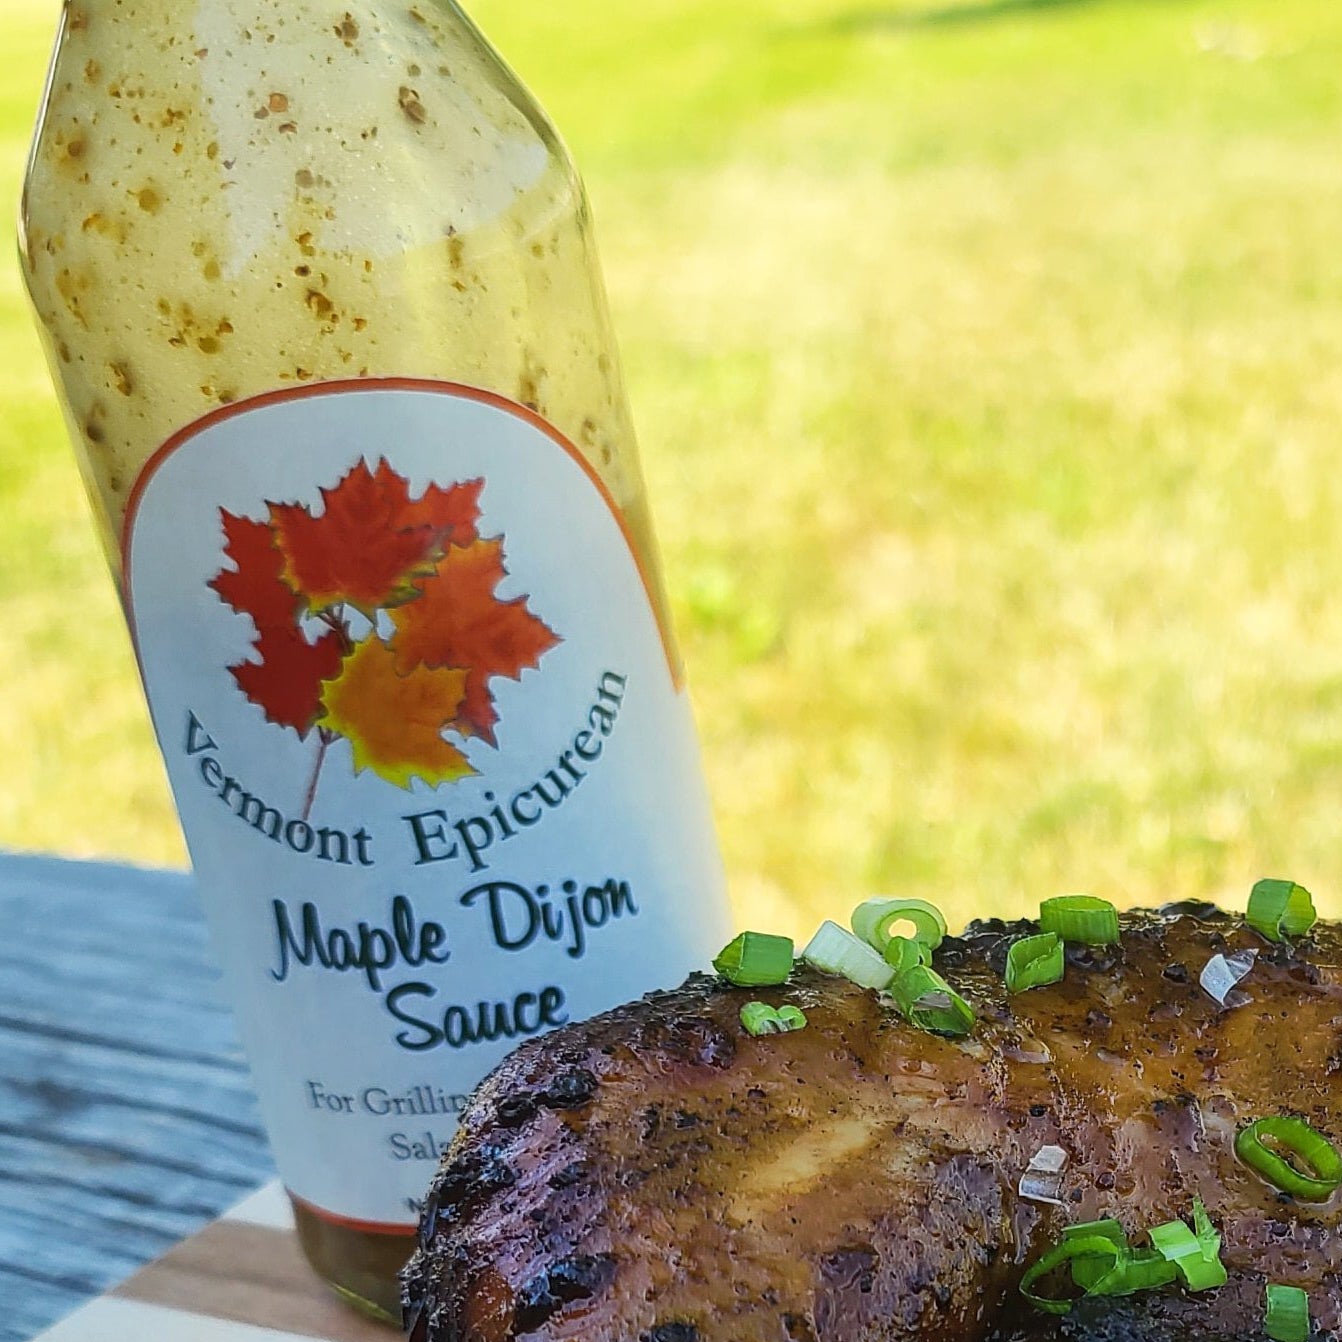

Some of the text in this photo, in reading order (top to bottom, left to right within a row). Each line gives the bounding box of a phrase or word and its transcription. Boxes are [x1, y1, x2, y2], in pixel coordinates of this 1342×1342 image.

[183, 667, 629, 874] Vermont Epicurean
[271, 874, 639, 994] Maple Dijon
[384, 981, 570, 1053] Sauce
[307, 1080, 469, 1116] For Grillin
